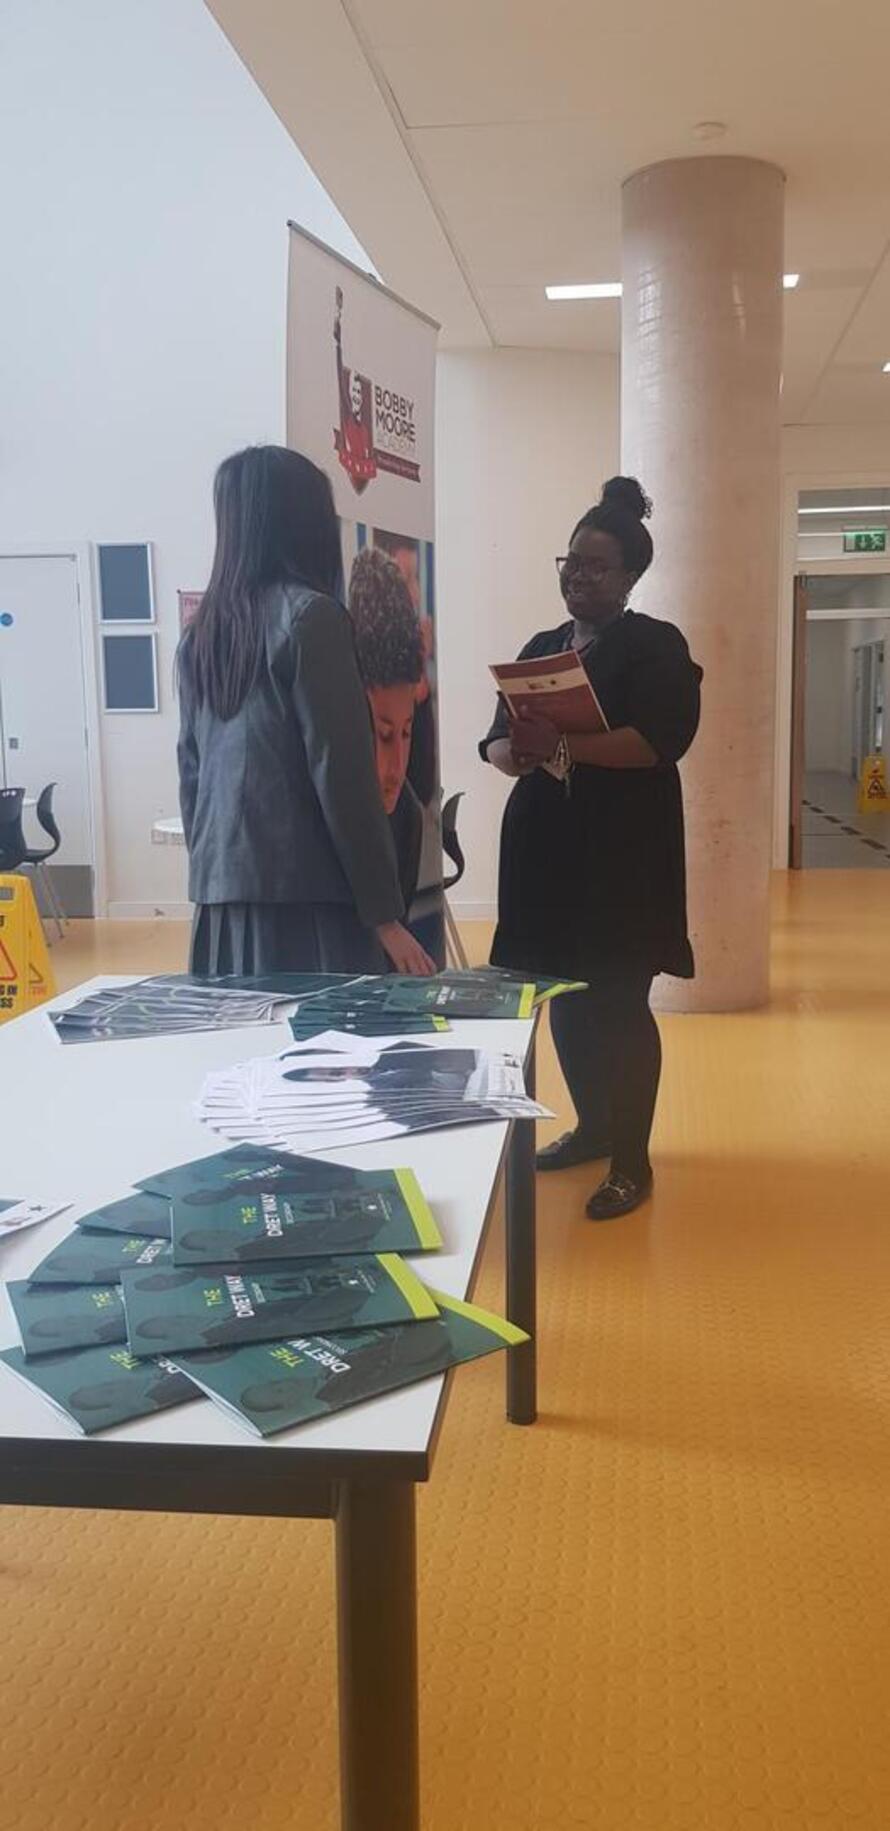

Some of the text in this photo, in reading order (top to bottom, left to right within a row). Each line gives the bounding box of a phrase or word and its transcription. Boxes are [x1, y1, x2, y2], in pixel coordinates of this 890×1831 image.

[375, 385, 414, 420] BOBBY
[375, 408, 416, 442] MOORE
[260, 1193, 284, 1237] DRET WAY
[224, 1274, 256, 1318] DRET WAY
[270, 1347, 304, 1368] THE
[303, 1347, 352, 1373] DRET
